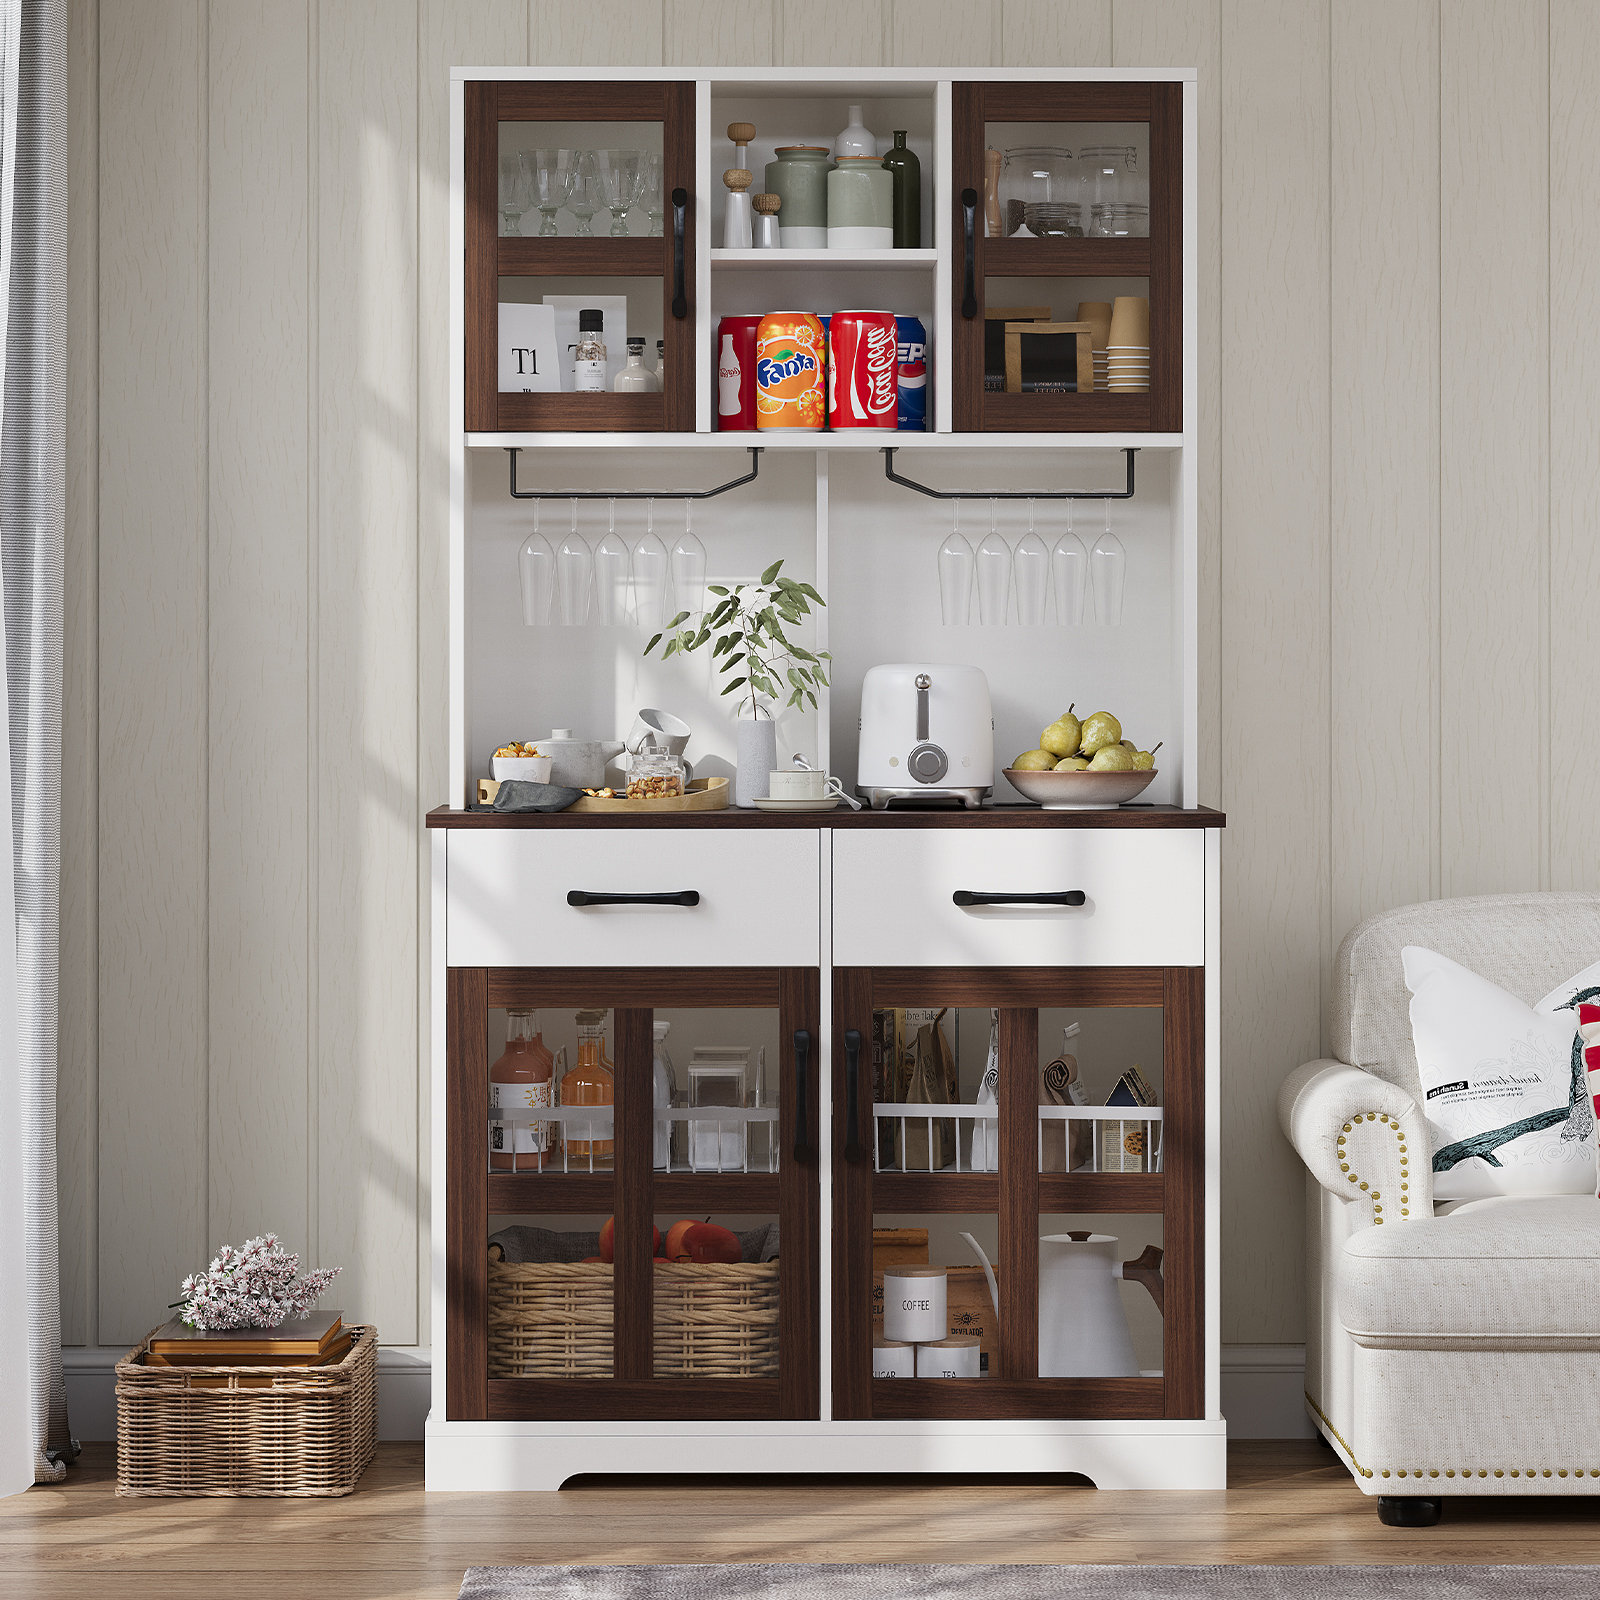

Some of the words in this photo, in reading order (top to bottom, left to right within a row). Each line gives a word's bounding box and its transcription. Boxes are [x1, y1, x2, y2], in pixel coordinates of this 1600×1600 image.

[511, 348, 540, 375] T1
[897, 343, 926, 363] EP
[757, 352, 816, 389] Fanta
[867, 322, 896, 415] Coca-Cola
[901, 1010, 920, 1020] ibre
[921, 1010, 943, 1020] flak
[902, 1300, 930, 1311] COFFEE
